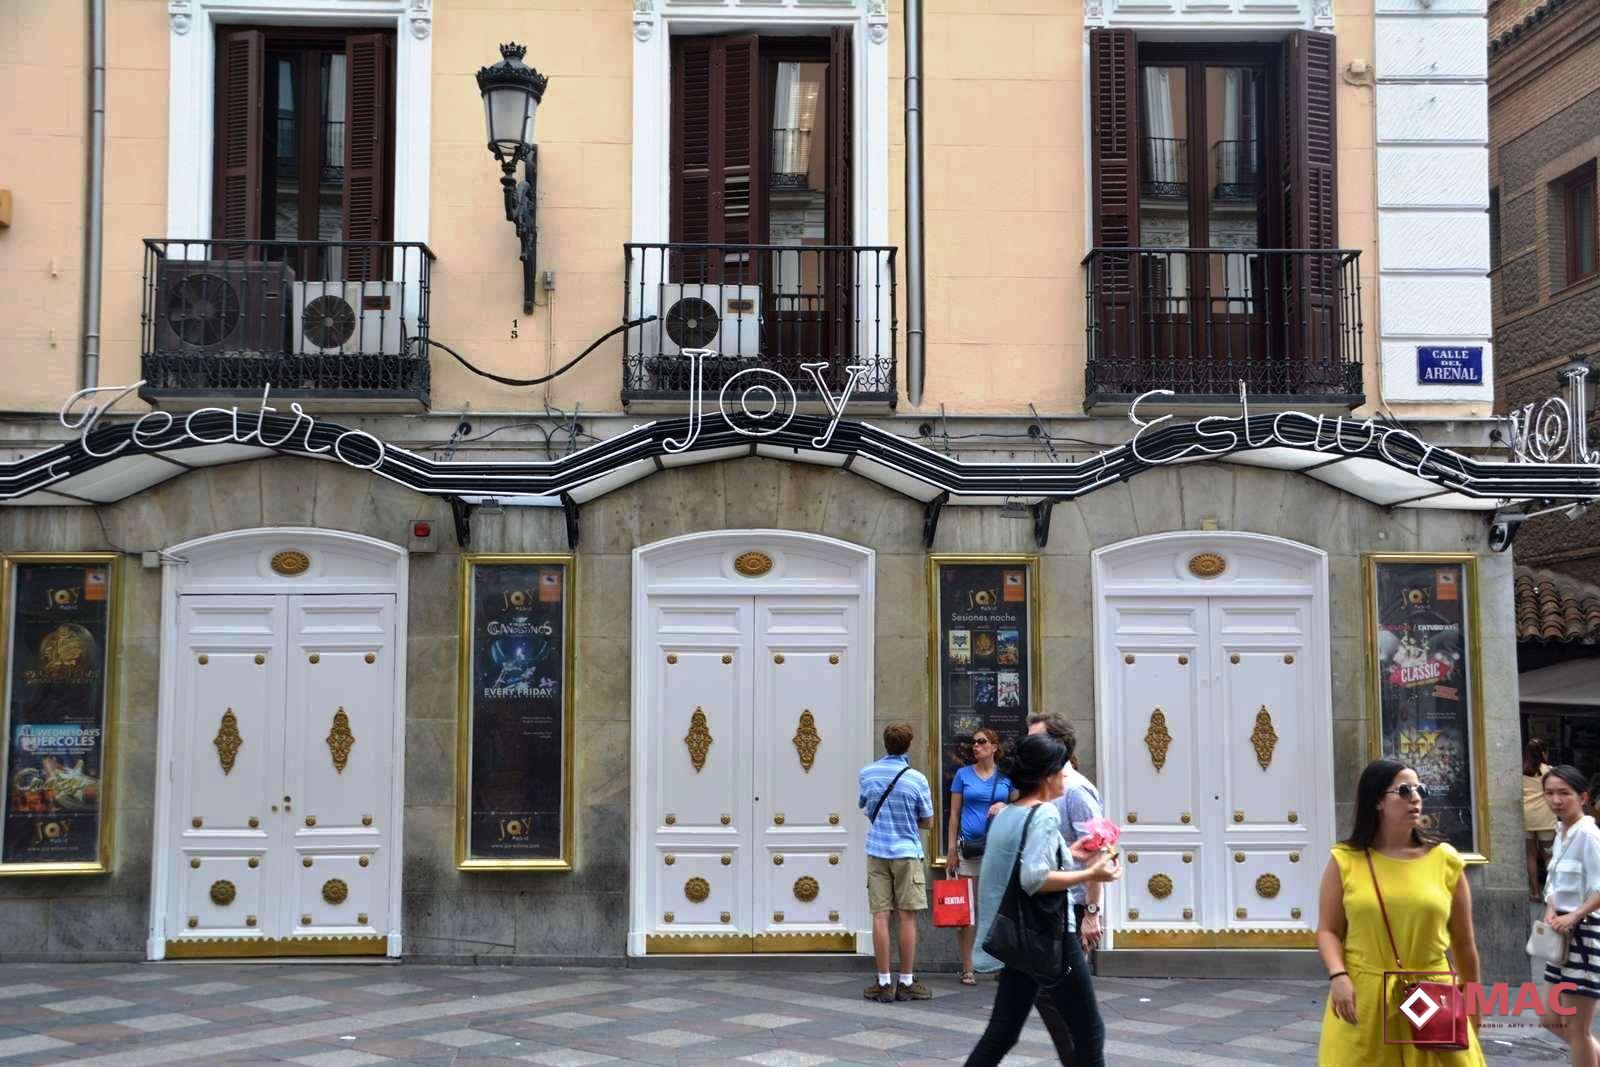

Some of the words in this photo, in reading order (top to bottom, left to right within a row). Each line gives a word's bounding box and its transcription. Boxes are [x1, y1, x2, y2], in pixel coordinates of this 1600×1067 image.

[1432, 350, 1469, 359] CALLE
[1424, 367, 1478, 380] ARENAL
[60, 380, 385, 470] Teatro
[951, 612, 988, 622] Sesiones
[990, 612, 1016, 622] noche
[1400, 662, 1441, 683] CLASSIC
[483, 687, 515, 696] EVERY
[517, 687, 553, 696] FRIDAY
